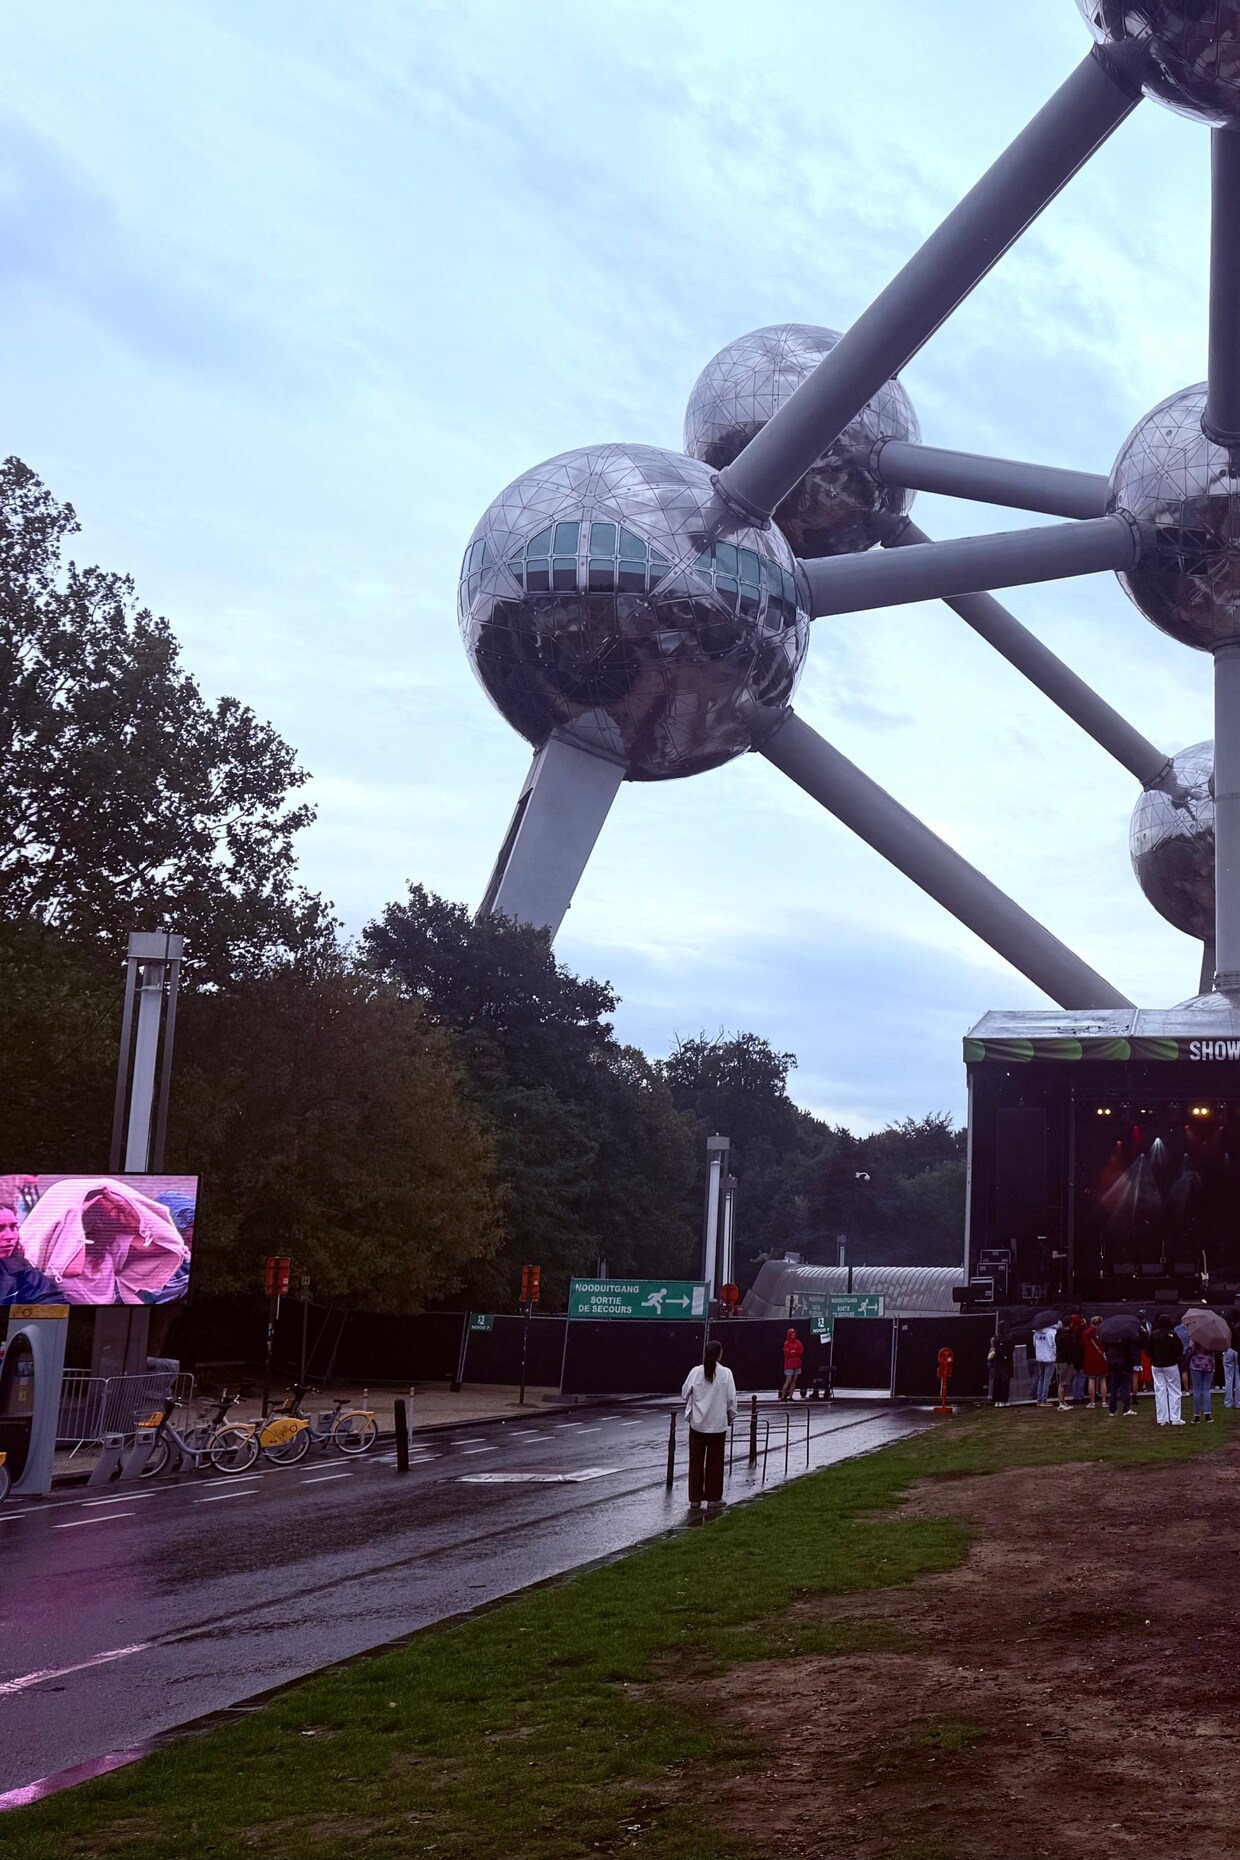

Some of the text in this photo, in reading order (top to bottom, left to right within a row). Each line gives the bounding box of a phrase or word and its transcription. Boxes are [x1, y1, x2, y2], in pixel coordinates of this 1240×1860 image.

[1189, 1040, 1240, 1061] SHOW
[575, 1283, 640, 1294] NOODUITGANG
[590, 1295, 622, 1305] SORTIE
[578, 1304, 632, 1314] DE SECOURS
